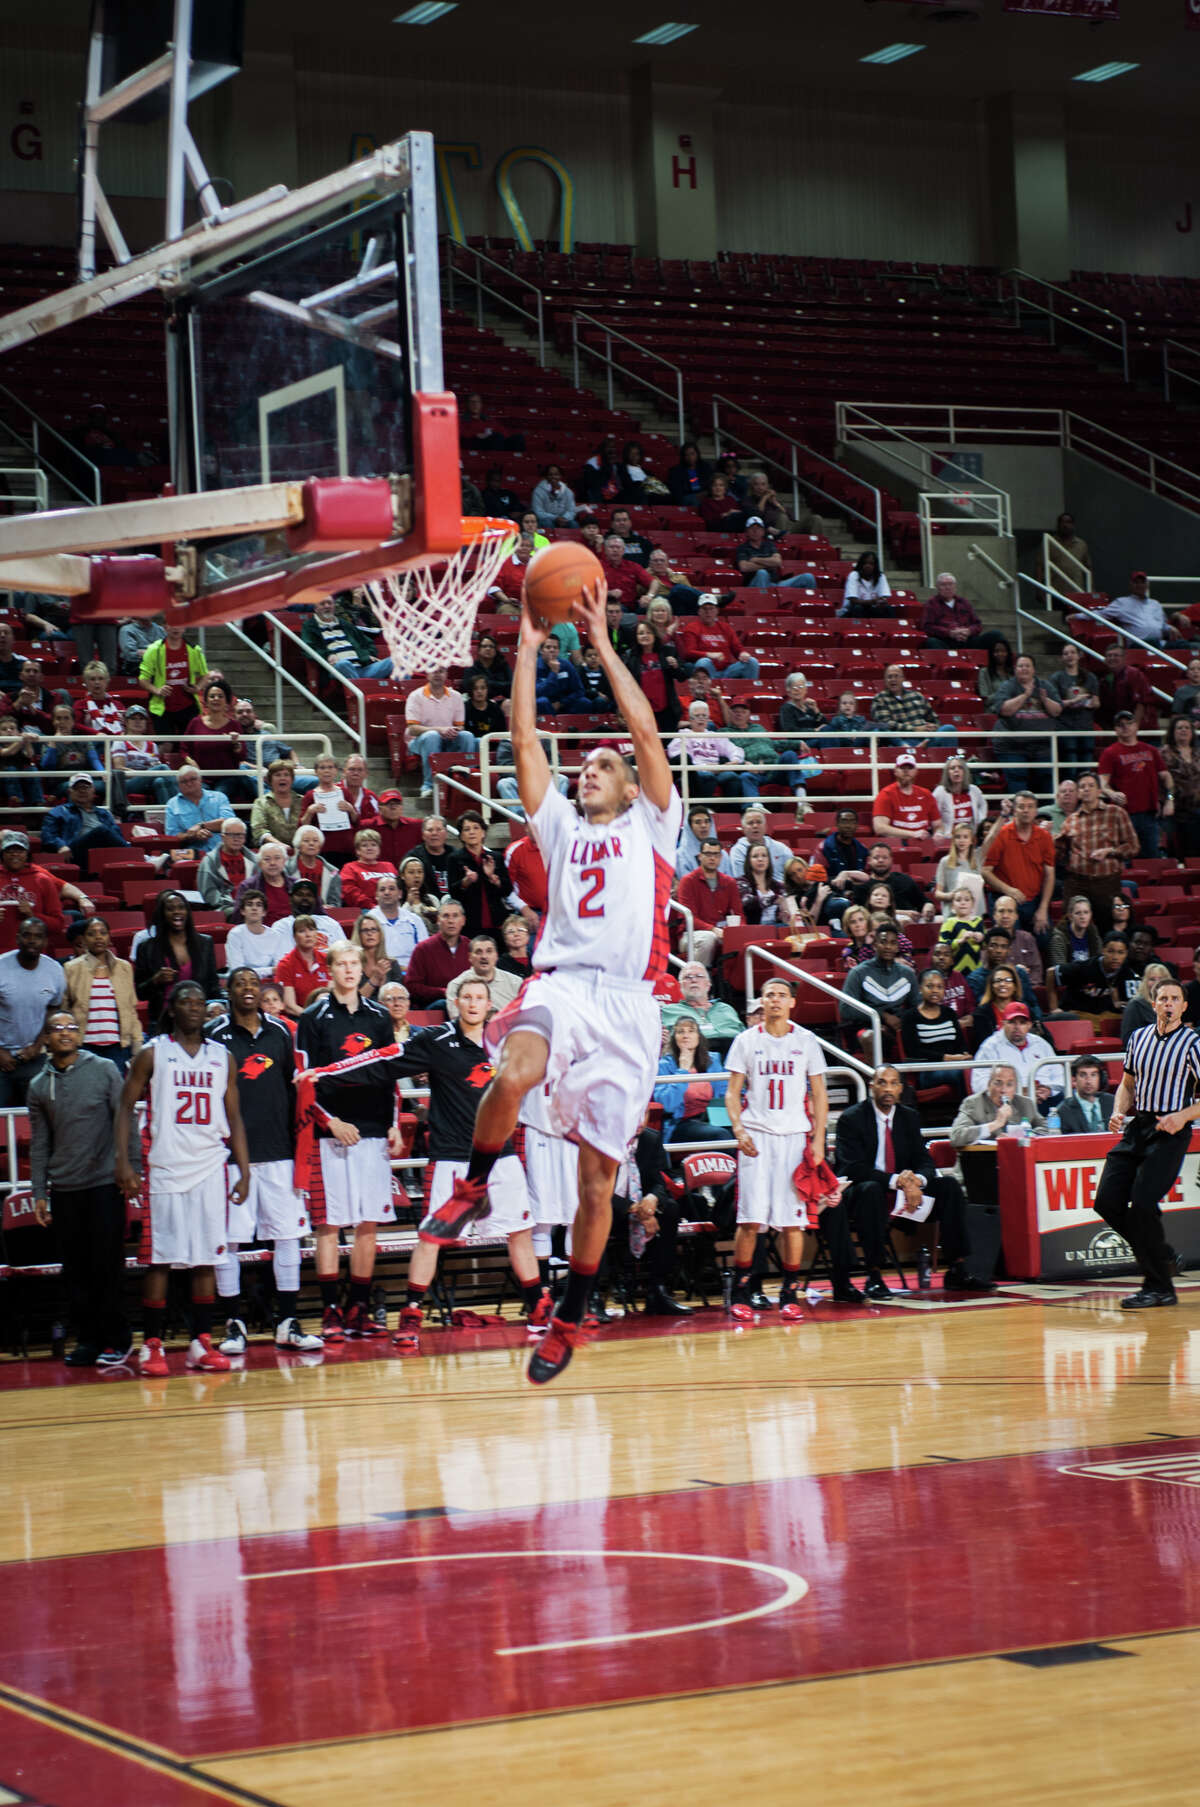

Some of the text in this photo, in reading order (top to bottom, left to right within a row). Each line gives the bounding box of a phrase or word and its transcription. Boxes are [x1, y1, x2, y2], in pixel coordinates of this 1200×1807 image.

[11, 123, 43, 161] G
[672, 155, 697, 189] H
[1175, 201, 1192, 233] J
[578, 866, 606, 919] 2
[173, 1069, 213, 1088] LAMAR
[758, 1060, 794, 1076] LAMAR
[175, 1090, 211, 1126] 20
[768, 1078, 784, 1110] 11
[688, 1156, 738, 1177] LAMAR
[1064, 1245, 1135, 1261] UNIVERS
